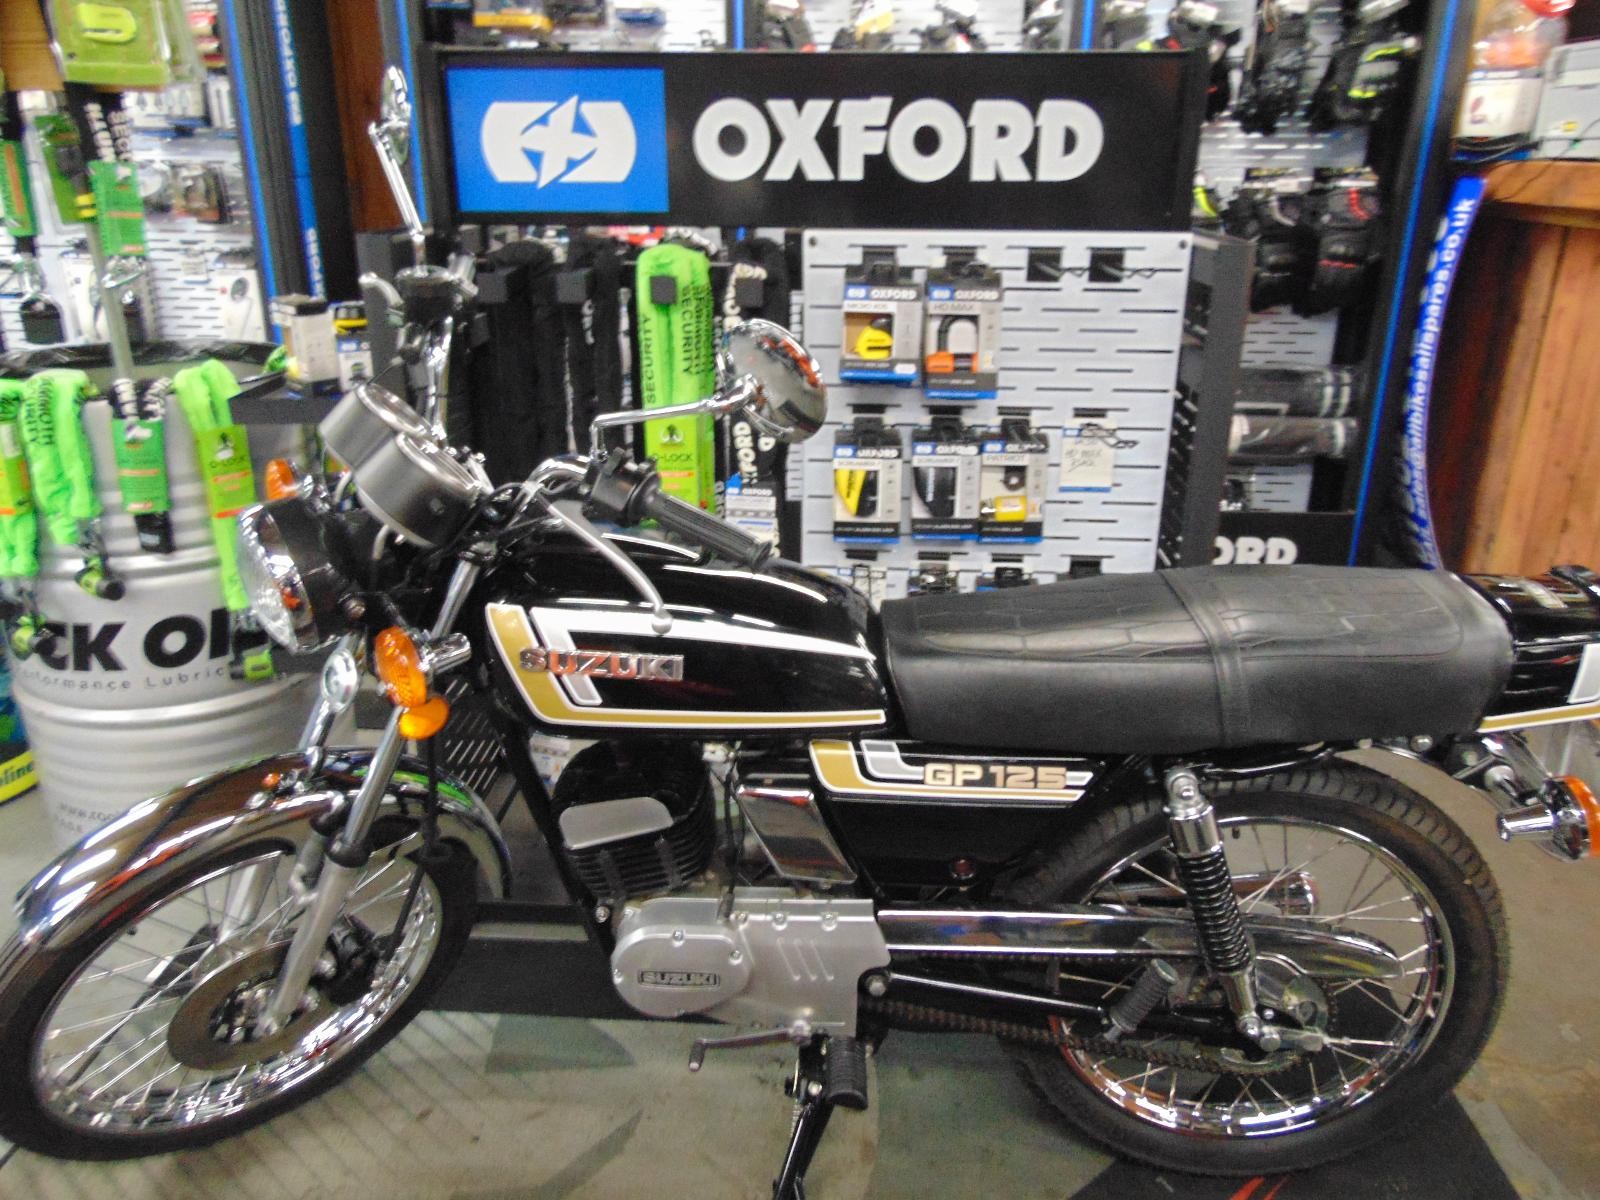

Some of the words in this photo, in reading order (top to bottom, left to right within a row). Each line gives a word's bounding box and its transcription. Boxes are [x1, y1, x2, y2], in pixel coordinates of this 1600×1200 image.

[693, 97, 1103, 183] OXFORD
[870, 288, 917, 300] OXFORD
[955, 289, 1000, 301] OXFORD
[641, 313, 656, 403] SECURITY
[936, 445, 978, 455] OXFORD
[1212, 536, 1298, 565] ORD
[38, 621, 127, 672] CK
[143, 606, 231, 668] OI
[146, 667, 226, 688] Lubric
[519, 647, 684, 682] SUZUKI
[924, 762, 984, 786] GP
[988, 765, 1067, 789] 125
[643, 971, 715, 985] SUZUKI
